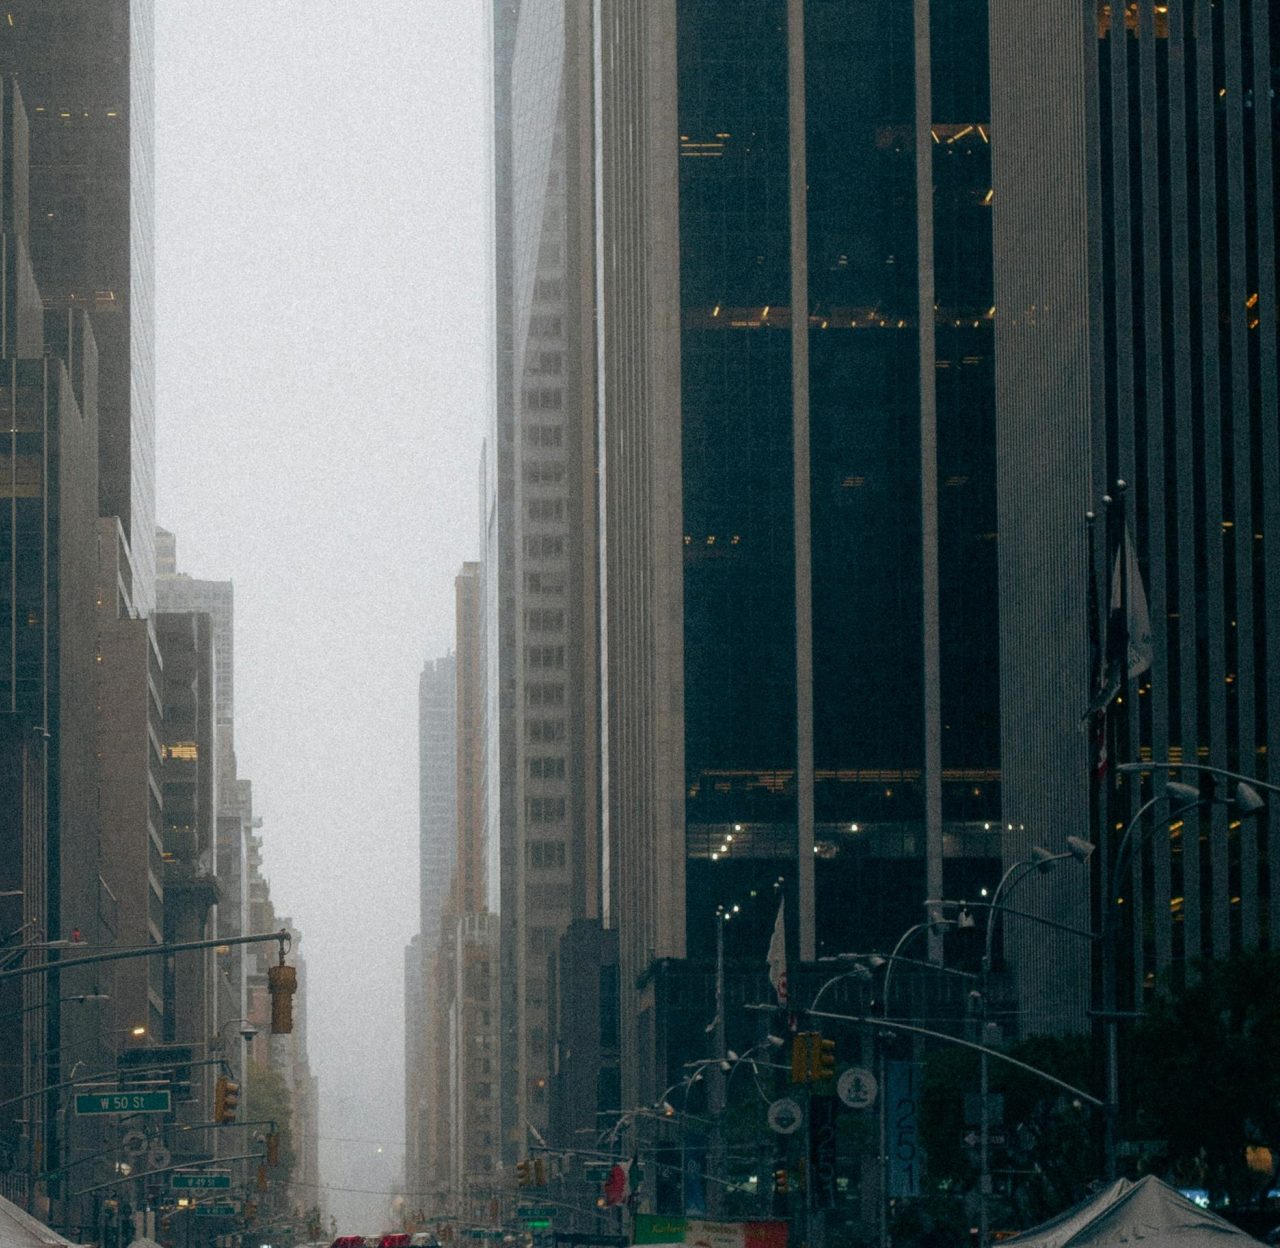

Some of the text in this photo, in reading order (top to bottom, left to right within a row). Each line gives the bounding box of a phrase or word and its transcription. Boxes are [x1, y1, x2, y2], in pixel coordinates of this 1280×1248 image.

[101, 1095, 145, 1110] W 50 St
